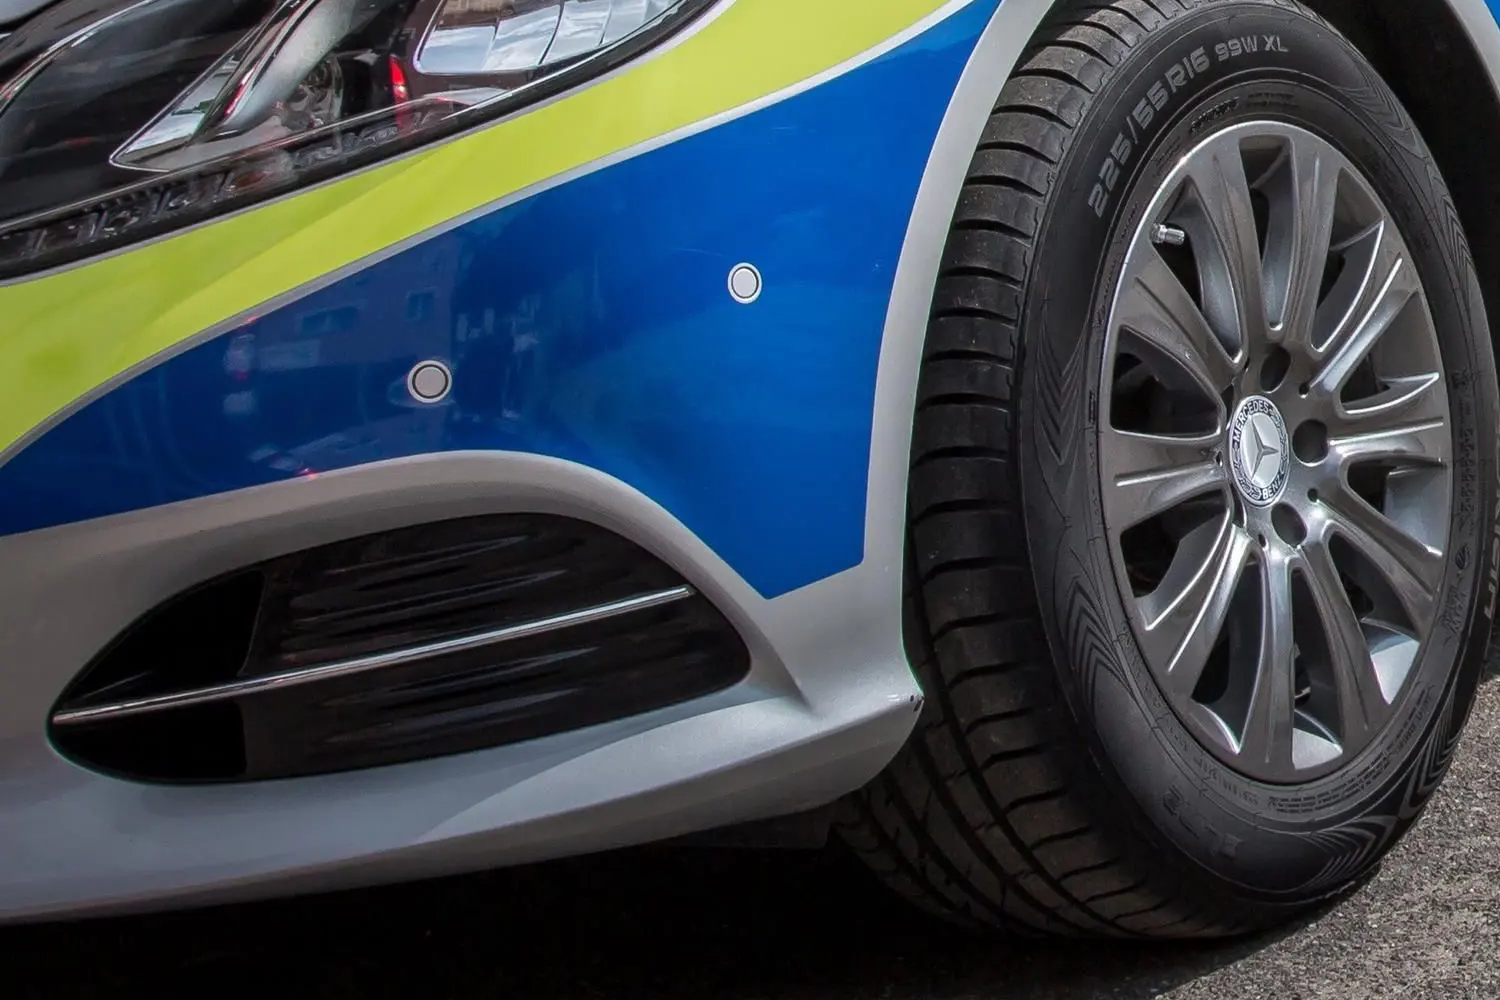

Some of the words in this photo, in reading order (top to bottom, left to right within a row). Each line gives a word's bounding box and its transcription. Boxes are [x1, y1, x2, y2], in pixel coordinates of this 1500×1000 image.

[1215, 35, 1258, 62] 99W
[1262, 34, 1289, 53] XL
[1232, 400, 1270, 442] MERCEDES
[1262, 474, 1284, 500] BENZ
